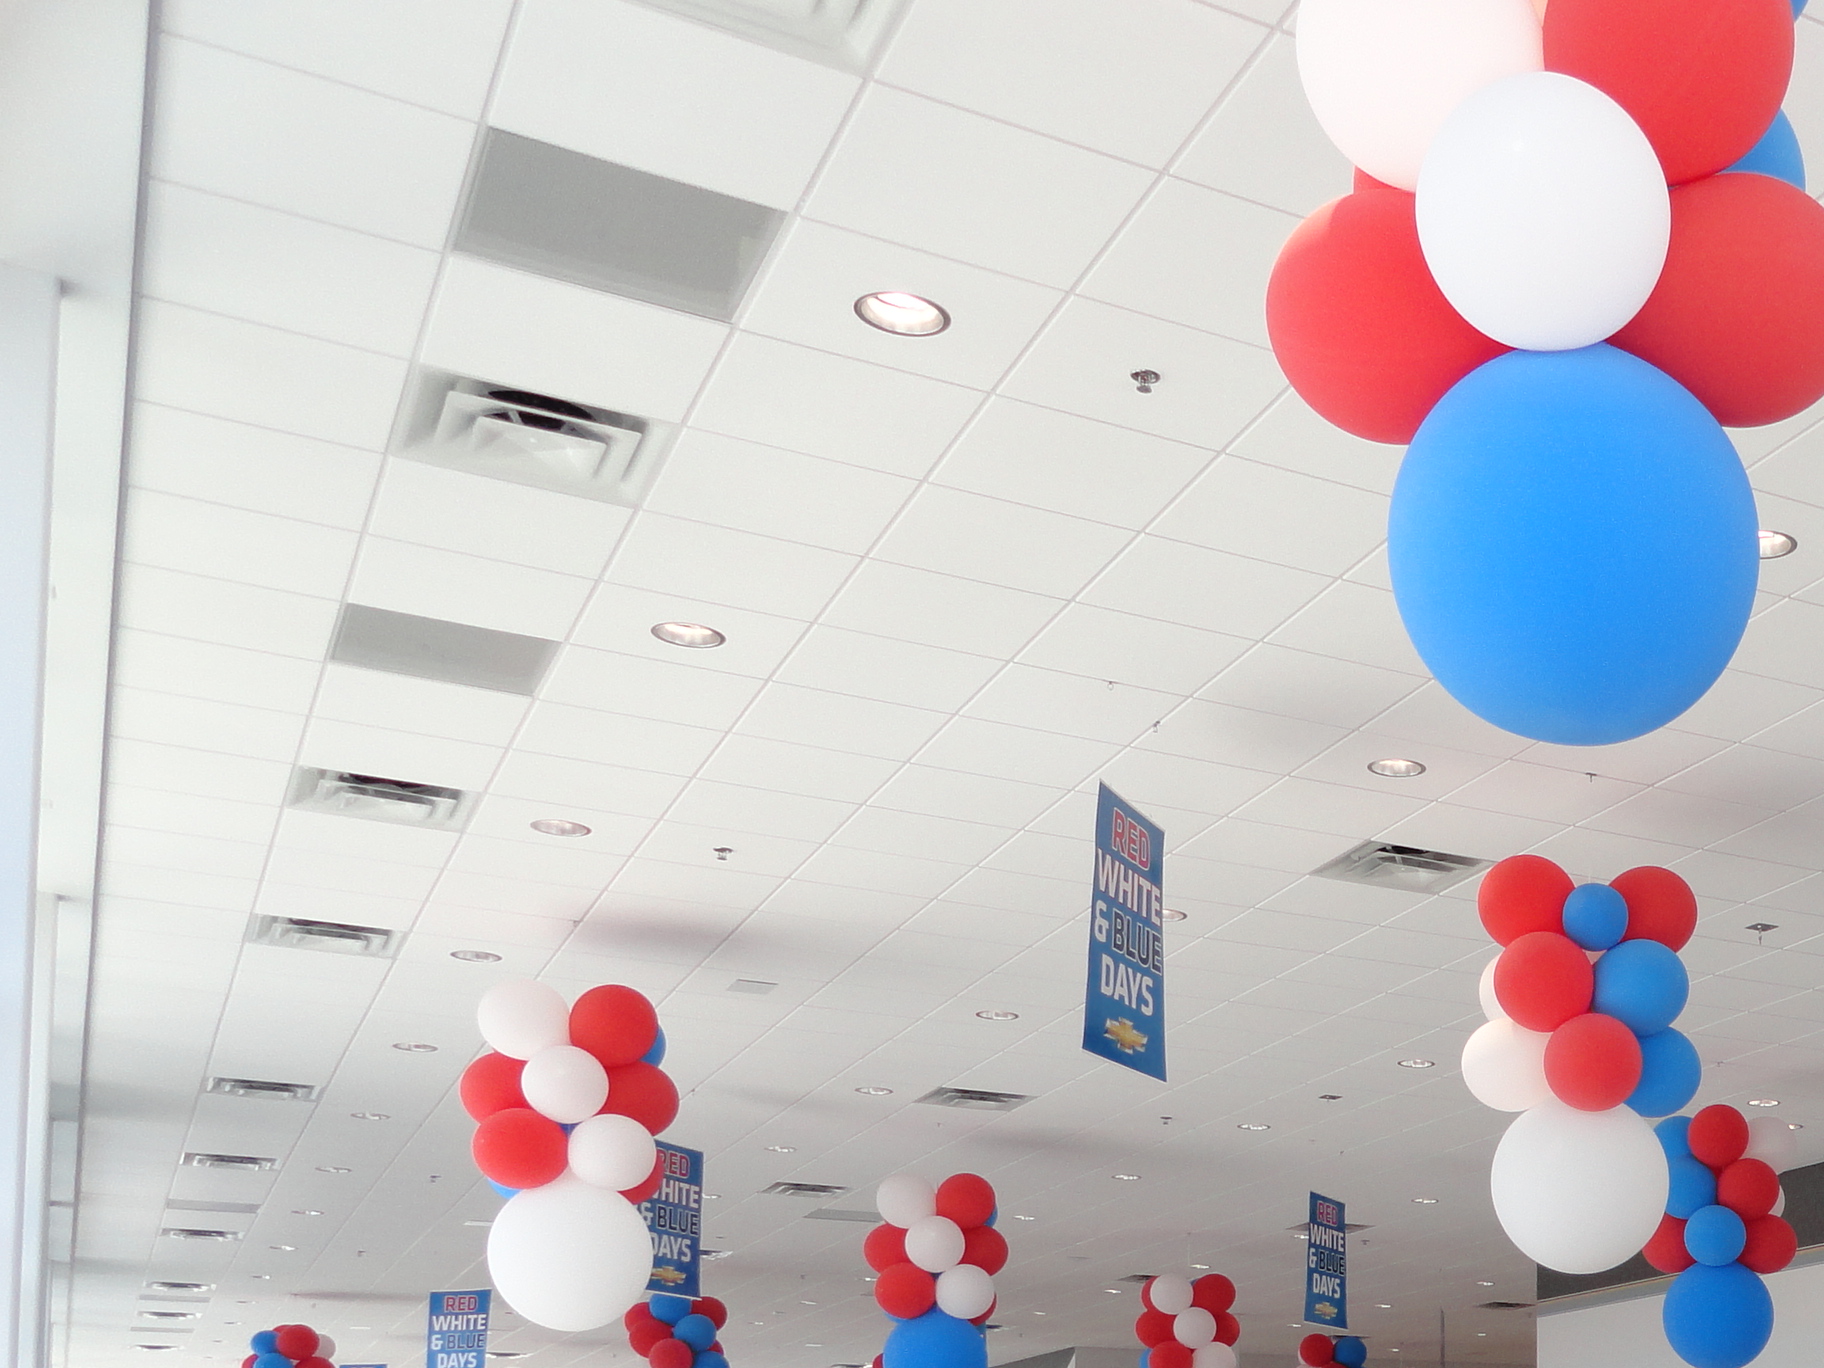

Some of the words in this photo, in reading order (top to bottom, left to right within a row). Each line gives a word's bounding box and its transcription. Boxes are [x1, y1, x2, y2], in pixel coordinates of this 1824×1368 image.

[1112, 807, 1151, 871] RED
[1098, 848, 1161, 927] WHITE
[1094, 899, 1109, 943] &
[1112, 907, 1162, 976] BLUE
[1100, 953, 1154, 1016] DAYS
[653, 1178, 700, 1209] HITE
[656, 1204, 699, 1236] BLUE
[1317, 1200, 1338, 1226] RED
[1310, 1223, 1345, 1252] WHITE
[1309, 1248, 1317, 1268] &
[1318, 1250, 1345, 1276] BLUE
[1313, 1273, 1340, 1298] DAYS
[444, 1295, 478, 1313] RED
[432, 1314, 487, 1331] WHITE
[431, 1334, 443, 1350] &
[446, 1333, 486, 1350] BLUE
[437, 1352, 477, 1368] DAYS
